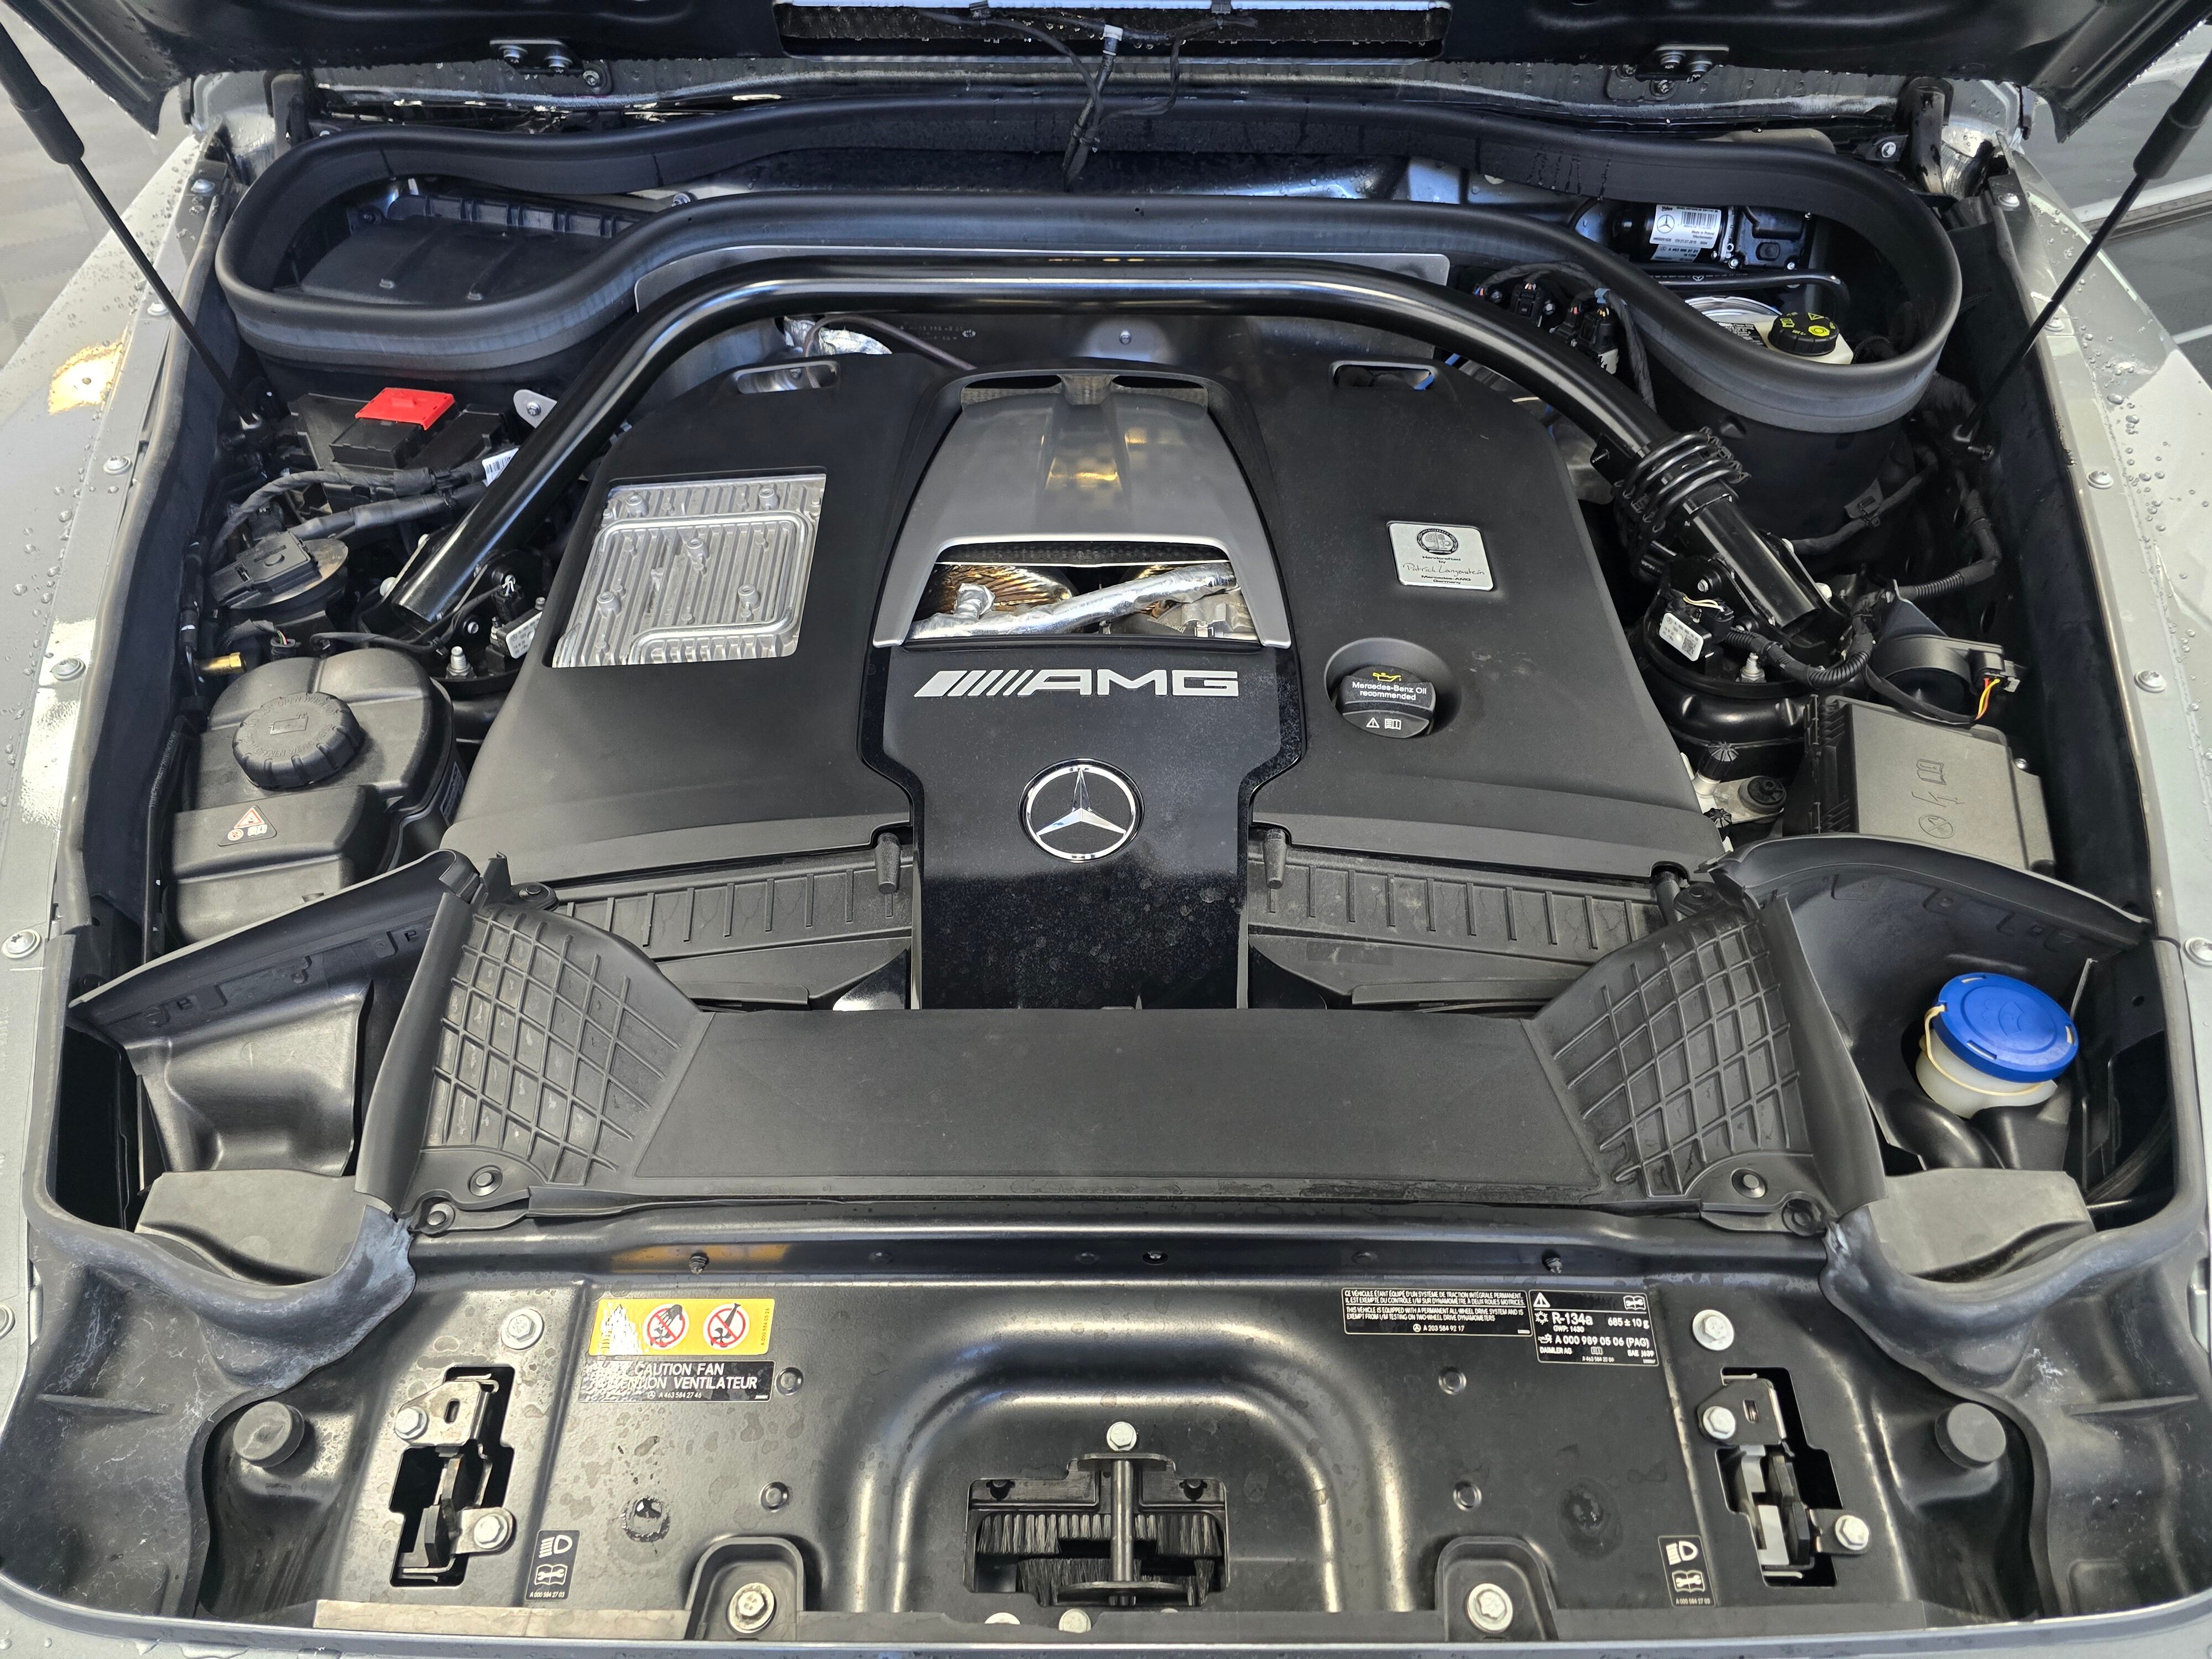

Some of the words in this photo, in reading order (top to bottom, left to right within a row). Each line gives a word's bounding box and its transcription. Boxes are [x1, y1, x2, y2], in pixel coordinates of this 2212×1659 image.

[1403, 563, 1437, 572] Patrick
[1018, 669, 1239, 696] AMG
[1352, 681, 1414, 693] Mercedes-Benz
[278, 696, 301, 707] OPEN
[1360, 691, 1416, 701] recommended
[1552, 1312, 1593, 1326] R-134a
[1608, 1317, 1623, 1326] 685
[1632, 1318, 1642, 1327] 10
[1643, 1320, 1650, 1329] g
[1555, 1335, 1562, 1344] A
[1563, 1335, 1580, 1345] 000
[1582, 1336, 1598, 1345] 989
[1599, 1337, 1611, 1346] 05
[1613, 1337, 1624, 1346] 06
[1626, 1337, 1650, 1349] (PAG)
[635, 1363, 692, 1376] CAUTION
[697, 1363, 724, 1375] FAN
[674, 1376, 758, 1389] VENTILATEUR
